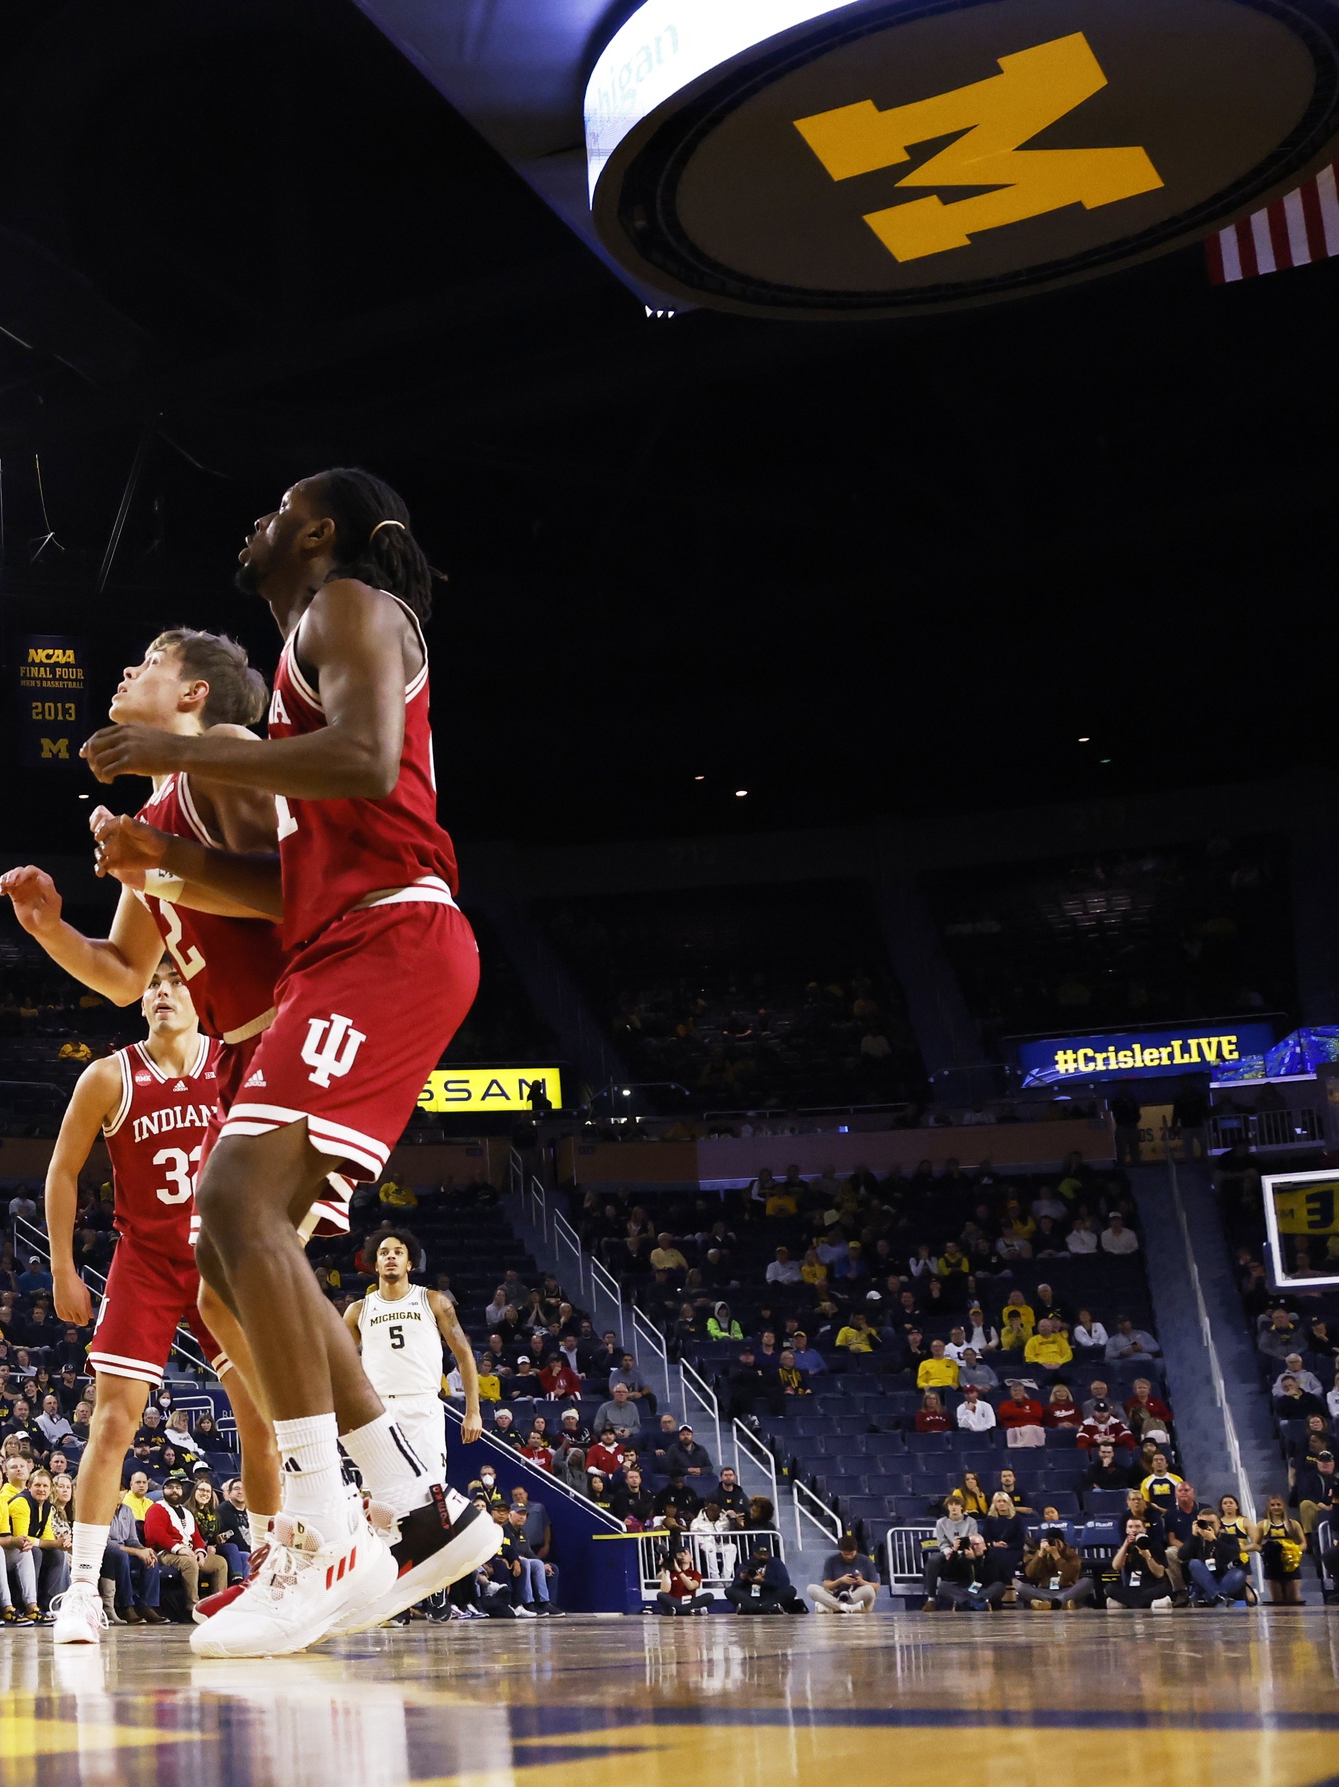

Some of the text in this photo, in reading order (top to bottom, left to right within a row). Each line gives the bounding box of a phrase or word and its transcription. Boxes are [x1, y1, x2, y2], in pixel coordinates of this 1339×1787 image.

[793, 31, 1164, 264] M
[28, 648, 76, 665] NCAA
[20, 666, 85, 680] FINAL FOUR
[42, 680, 84, 689] BASKETBALL
[32, 702, 76, 721] 2013
[40, 738, 70, 759] M
[160, 898, 207, 982] 2
[1054, 1034, 1240, 1075] #CrislerLIVE
[417, 1078, 547, 1102] SSAN
[132, 1104, 218, 1143] INDIAN
[369, 1311, 422, 1327] MICHIGAN
[388, 1325, 405, 1350] 5
